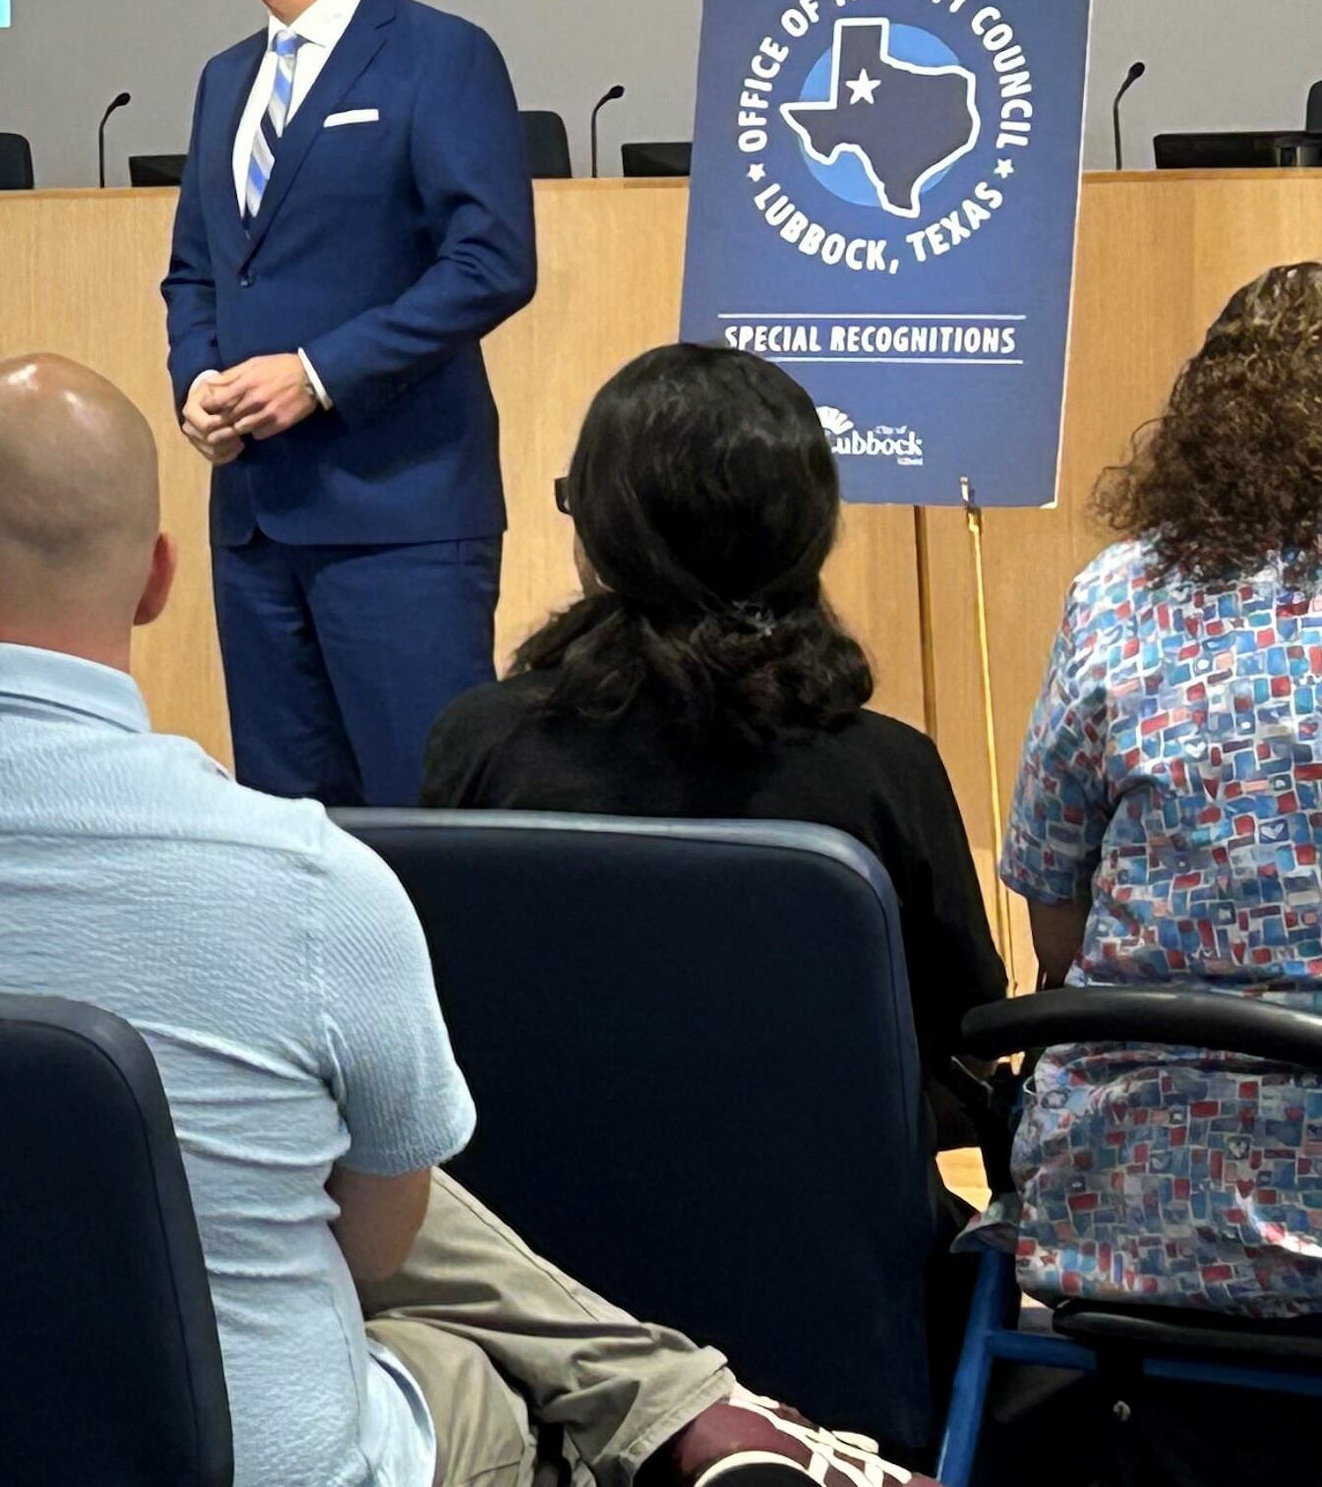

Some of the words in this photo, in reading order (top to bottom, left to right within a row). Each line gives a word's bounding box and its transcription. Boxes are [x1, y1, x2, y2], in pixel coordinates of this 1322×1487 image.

[737, 36, 790, 154] OFFICE
[972, 5, 1034, 148] COUNCIL
[754, 182, 901, 275] LUBBOCK,
[906, 179, 1005, 264] TEXAS
[724, 325, 822, 353] SPECIAL
[829, 325, 1017, 354] RECOGNITIONS
